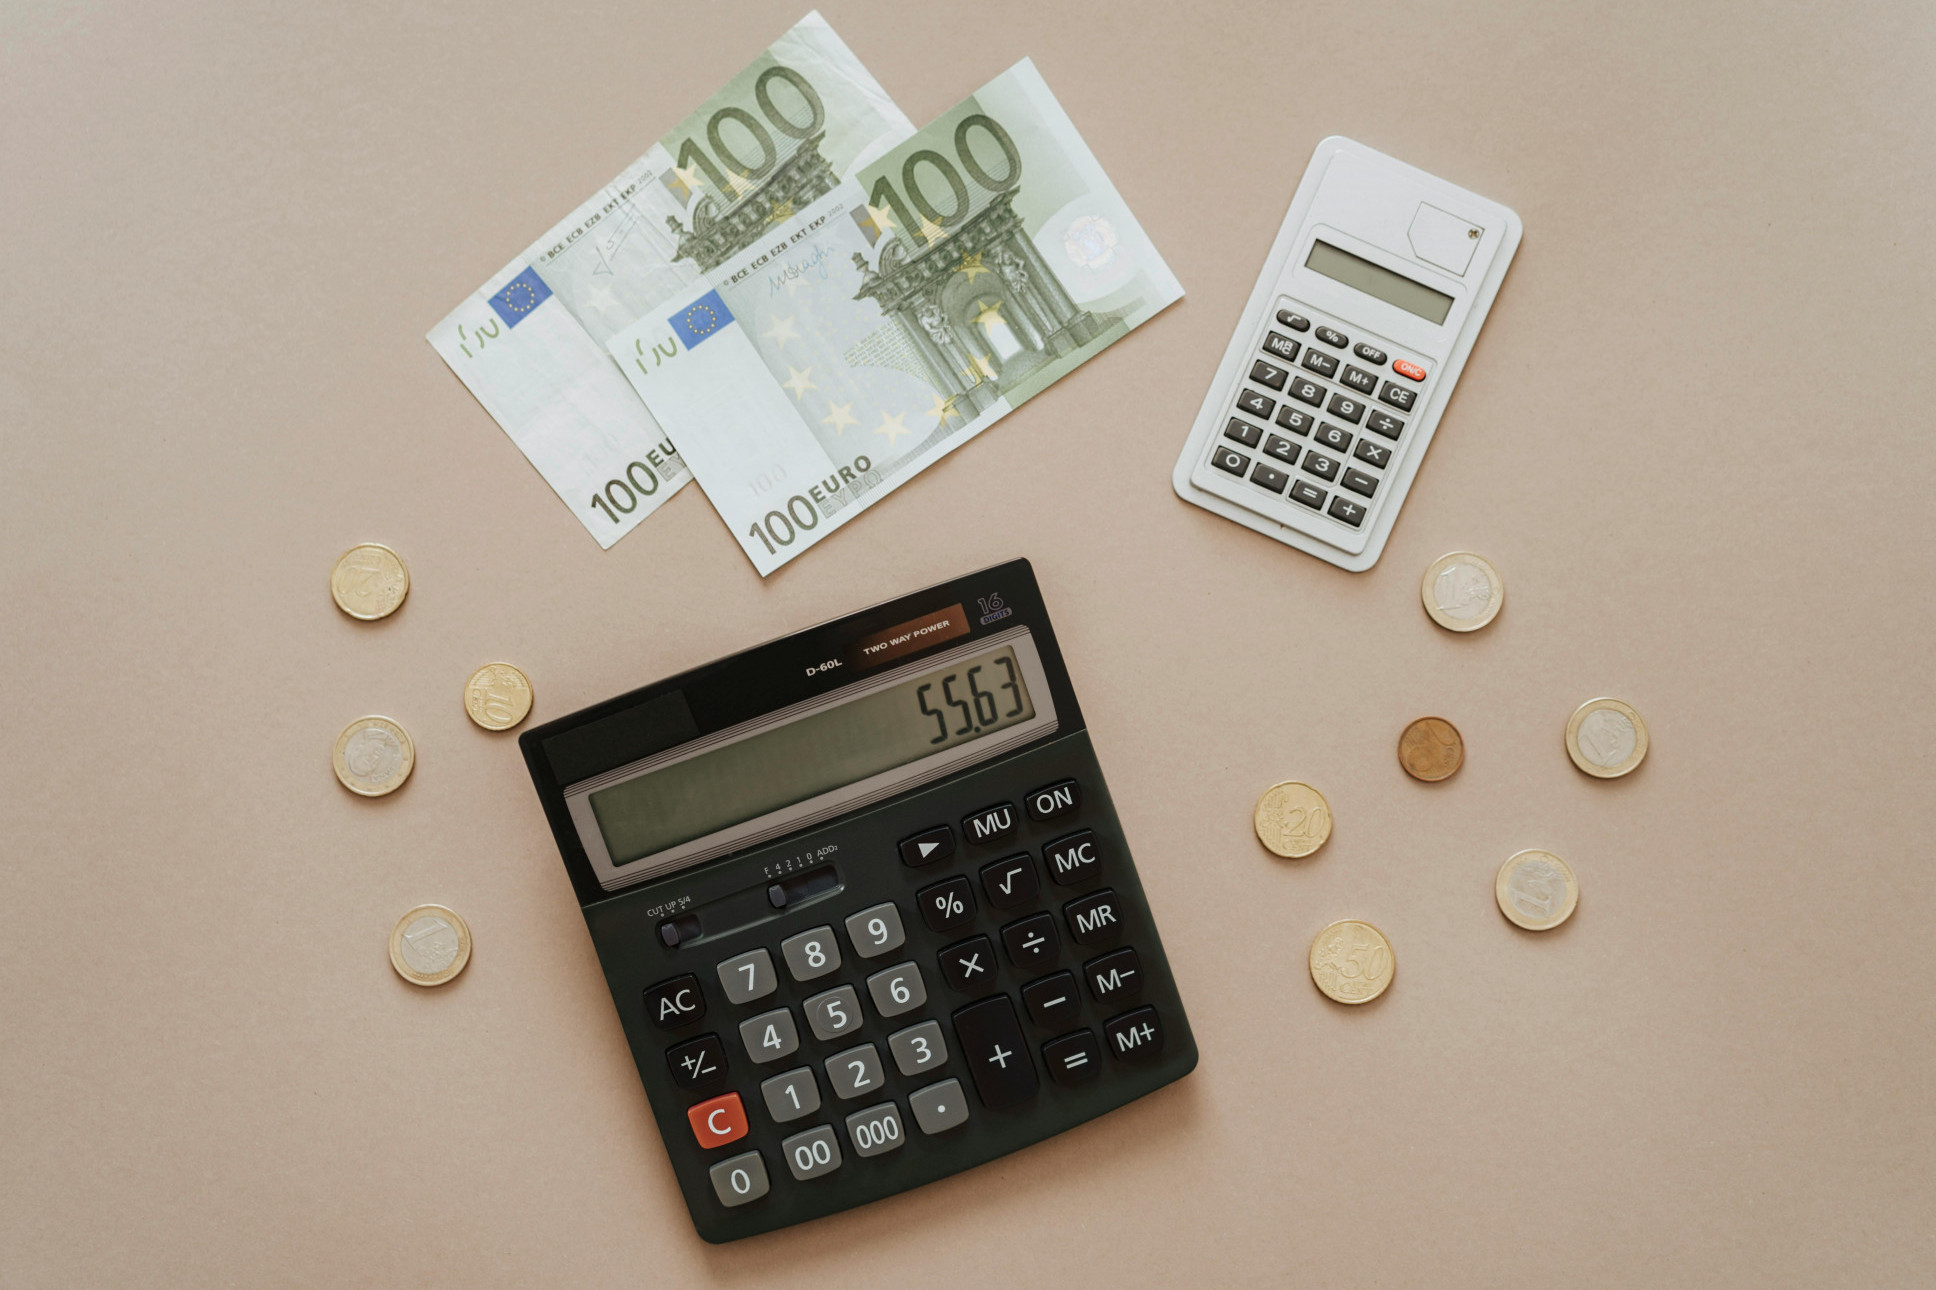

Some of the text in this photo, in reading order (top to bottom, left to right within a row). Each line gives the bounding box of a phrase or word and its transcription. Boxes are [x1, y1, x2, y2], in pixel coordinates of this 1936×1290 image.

[676, 65, 825, 204] 100
[869, 113, 1023, 249] 100
[547, 243, 565, 259] BCE
[566, 227, 584, 244] ECB
[584, 213, 602, 229] EZB
[602, 198, 620, 214] EKT
[620, 184, 636, 200] EKP
[730, 267, 749, 284] BCE
[751, 255, 769, 270] ECB
[770, 242, 788, 257] EZB
[789, 228, 808, 244] EKT
[808, 215, 826, 231] EKP
[1362, 346, 1381, 359] OFF
[1264, 367, 1278, 380] 7
[1301, 384, 1316, 398] 8
[1340, 401, 1354, 414] 9
[1350, 371, 1369, 386] M+
[1389, 387, 1409, 404] CE
[1250, 397, 1263, 410] 4
[1289, 414, 1303, 427] 5
[1328, 430, 1342, 443] 6
[1240, 425, 1249, 438] 1
[1275, 441, 1291, 456] 2
[1315, 458, 1329, 472] 3
[590, 461, 659, 525] 100
[749, 455, 872, 556] 100 EURO
[977, 592, 1004, 615] 16
[983, 608, 1011, 624] DIGITS
[863, 620, 951, 656] TWO WAY POWER
[805, 658, 843, 677] D-60L
[916, 656, 1024, 745] 55.63
[973, 786, 1073, 838] MU ON
[764, 867, 770, 875] F
[775, 863, 781, 871] 4
[785, 859, 792, 868] 2
[647, 895, 692, 917] CUT UP 5/4
[738, 963, 755, 991] 7
[804, 941, 826, 968] 8
[867, 918, 888, 945] 9
[1054, 842, 1096, 873] MC
[658, 988, 696, 1021] AC
[762, 1023, 782, 1050] 4
[826, 1001, 848, 1029] 5
[890, 977, 910, 1004] 6
[1076, 904, 1117, 934] MR
[707, 1108, 732, 1136] C
[794, 1139, 831, 1171] 00
[856, 1115, 899, 1149] 000
[1115, 1022, 1155, 1052] M+
[784, 1084, 801, 1109] 1
[848, 1060, 871, 1088] 2
[910, 1036, 932, 1063] 3
[731, 1168, 751, 1194] 0
